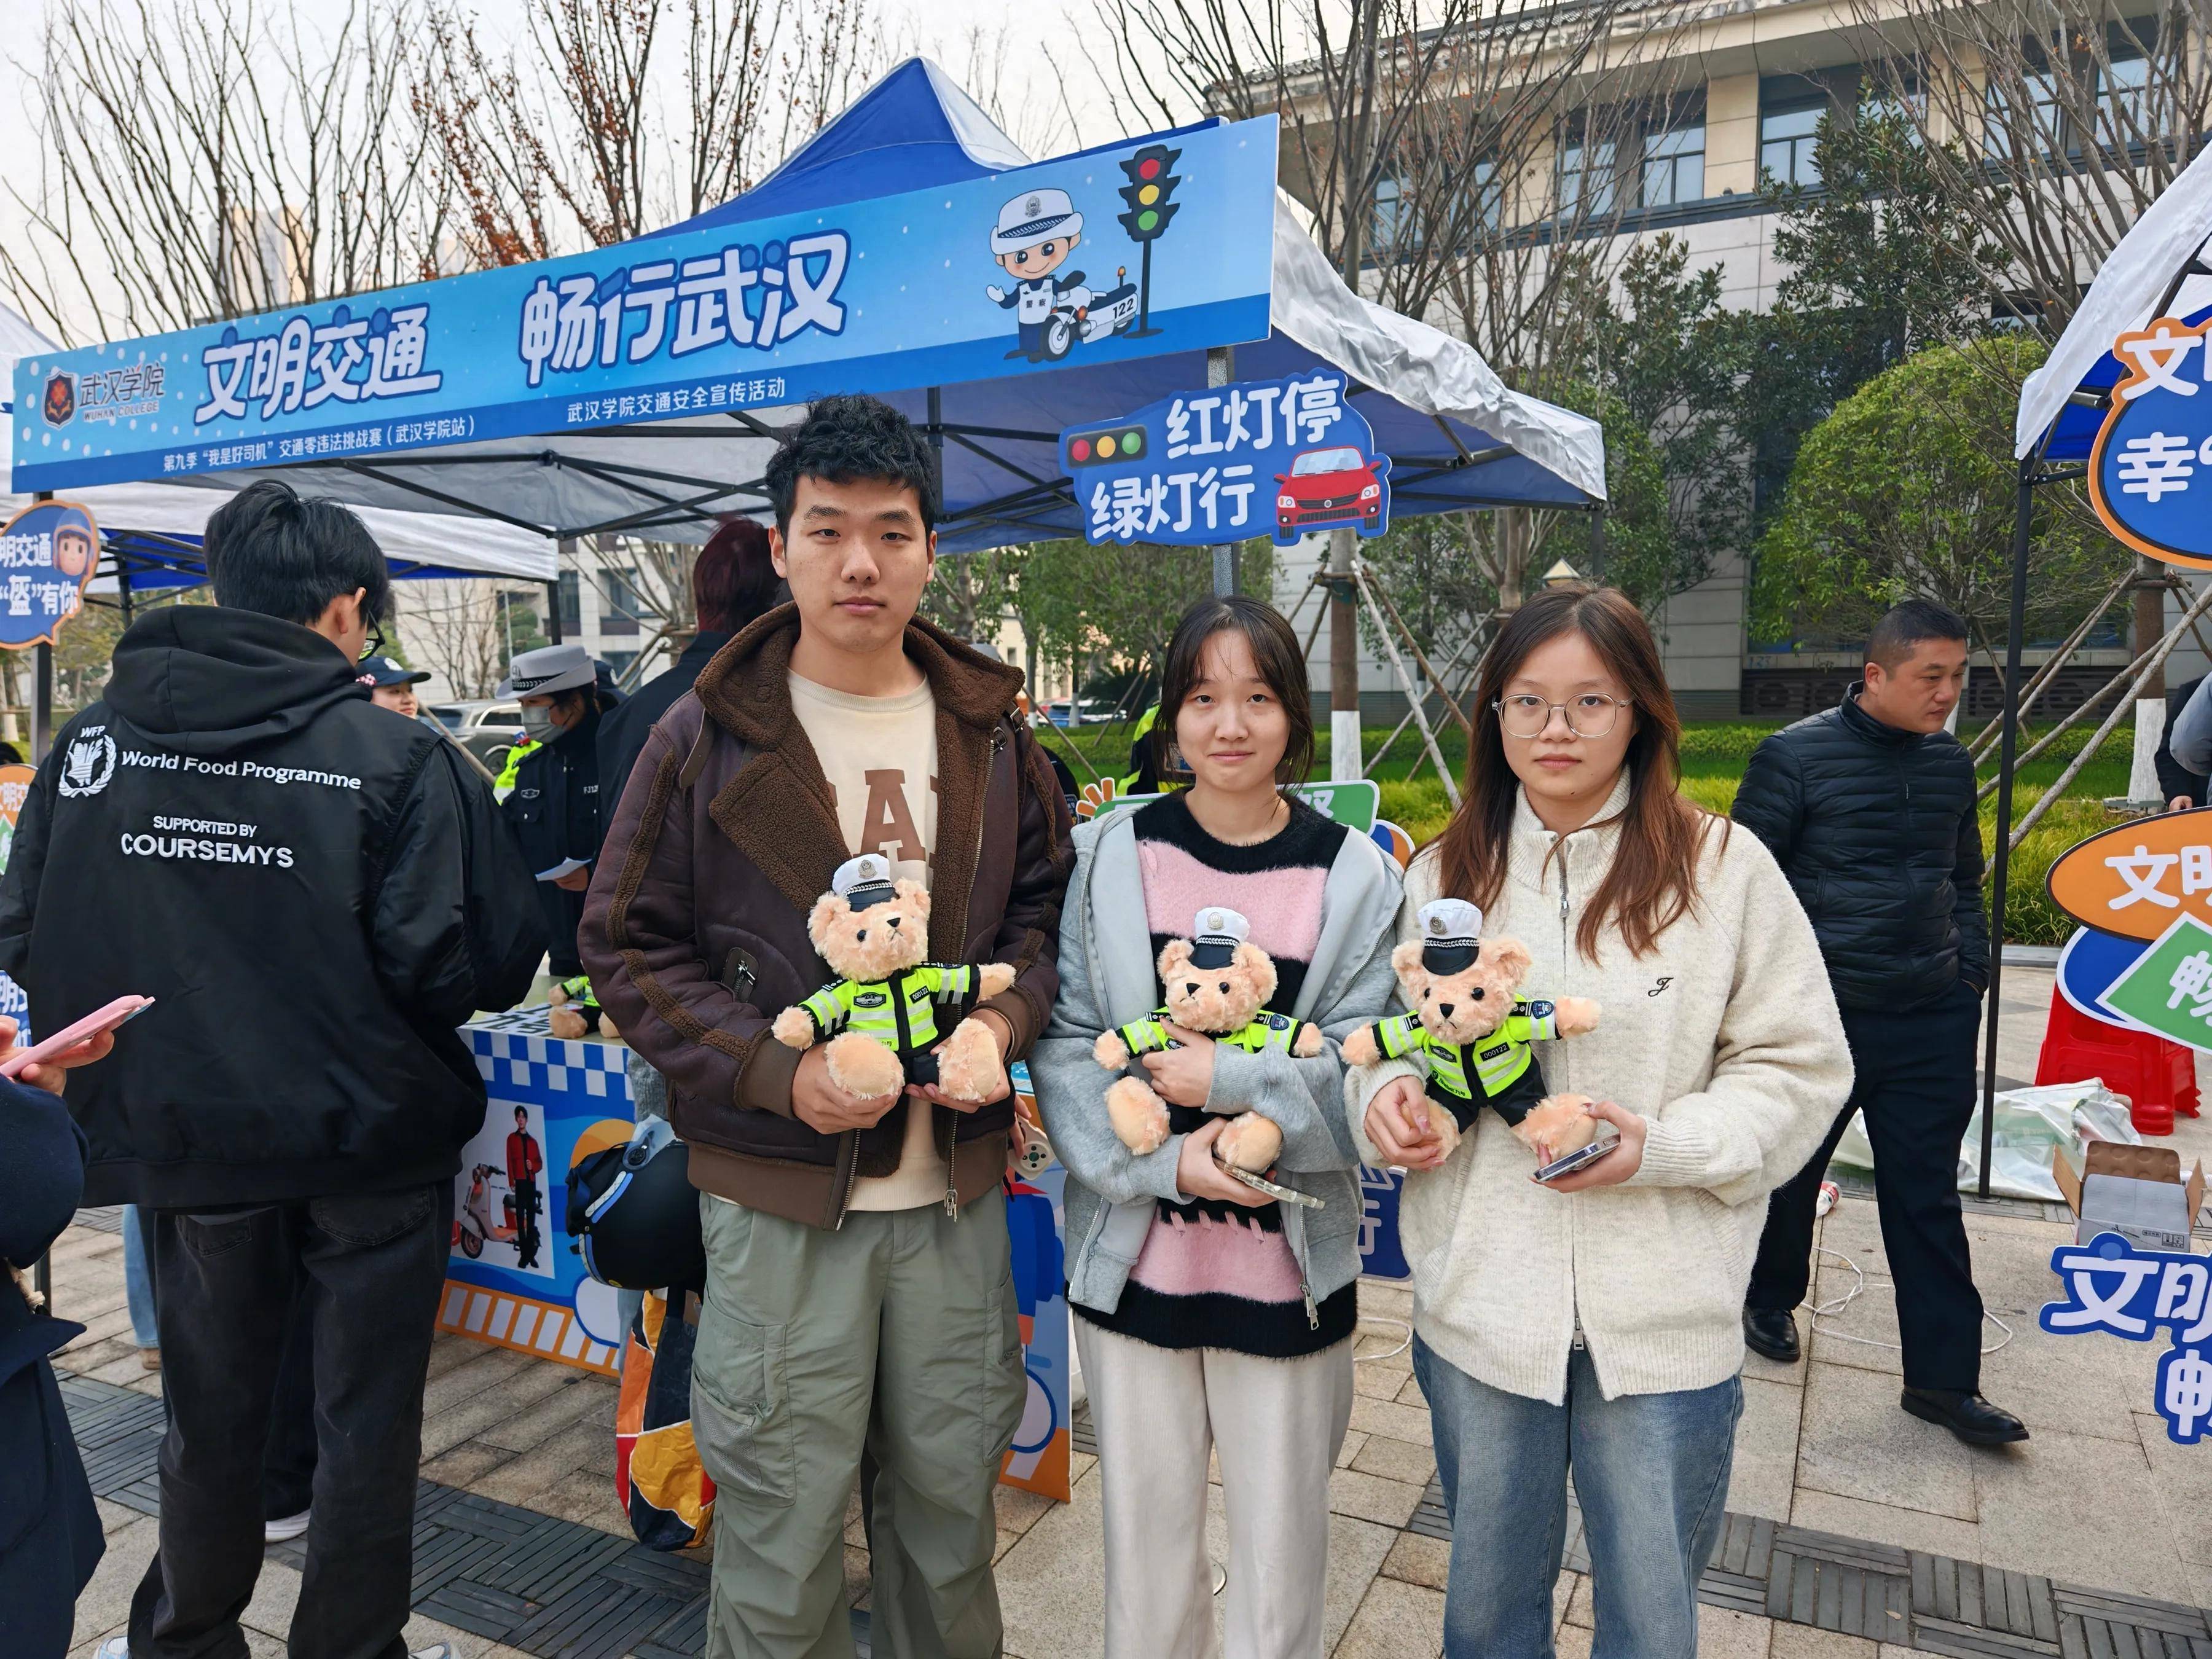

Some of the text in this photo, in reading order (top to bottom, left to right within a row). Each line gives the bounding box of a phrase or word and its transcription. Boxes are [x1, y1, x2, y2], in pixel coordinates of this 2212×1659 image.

[520, 232, 848, 385] 畅行武汉
[1113, 298, 1134, 319] 122
[195, 305, 442, 424] 文明交通
[2122, 327, 2212, 401] 文
[79, 361, 165, 407] 武汉学院
[567, 377, 785, 423] 武汉学院交通安全宣传活动
[84, 402, 159, 421] WUHAN COLLEGE
[1166, 376, 1341, 458] 红灯停
[1091, 465, 1255, 538] 绿灯行
[80, 725, 106, 737] WFP
[122, 751, 362, 790] World Food Programme
[153, 816, 257, 837] SUPPORTED BY
[121, 833, 294, 868] COURSEMYS
[912, 987, 928, 1001] 000122
[1483, 1045, 1508, 1059] 000122
